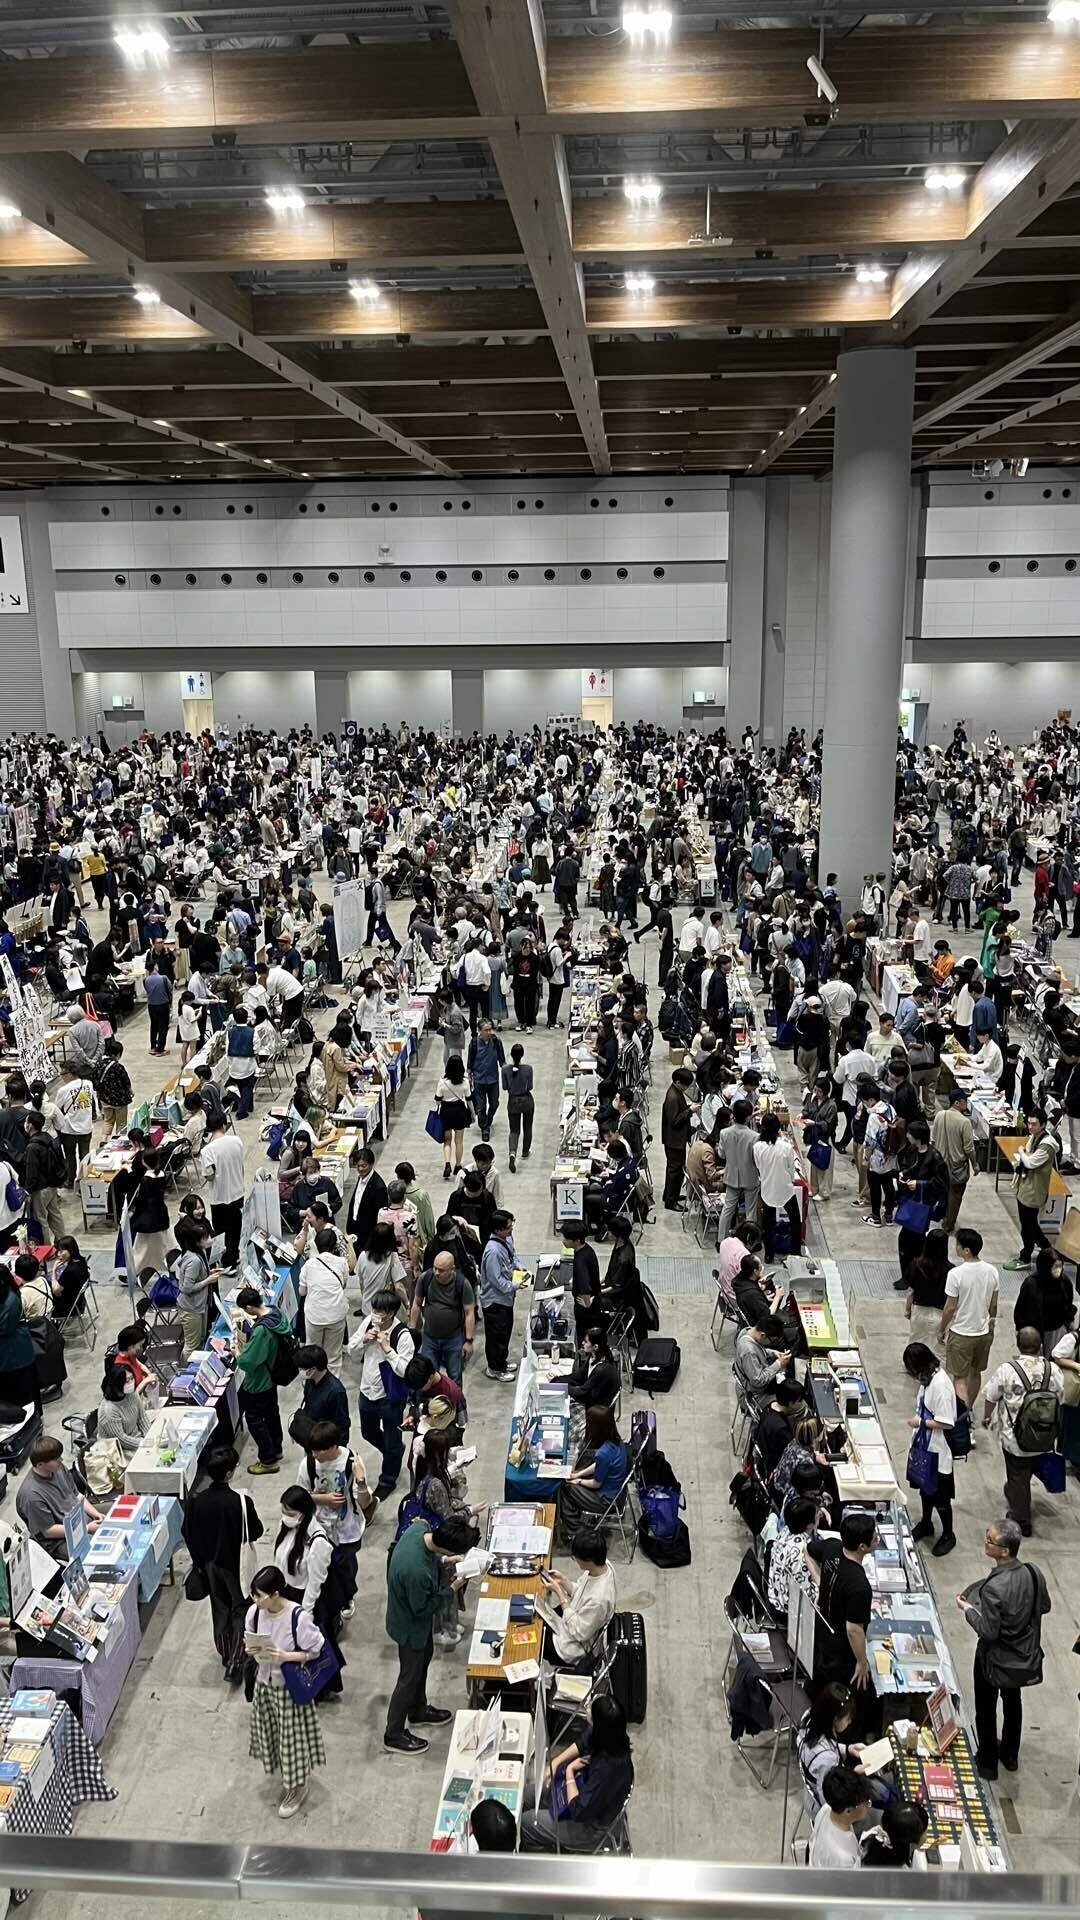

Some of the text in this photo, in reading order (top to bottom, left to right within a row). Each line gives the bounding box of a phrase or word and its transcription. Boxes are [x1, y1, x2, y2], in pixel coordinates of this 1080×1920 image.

[705, 881, 711, 890] K
[88, 1184, 101, 1199] L
[564, 1189, 577, 1205] K
[1045, 1199, 1056, 1215] J
